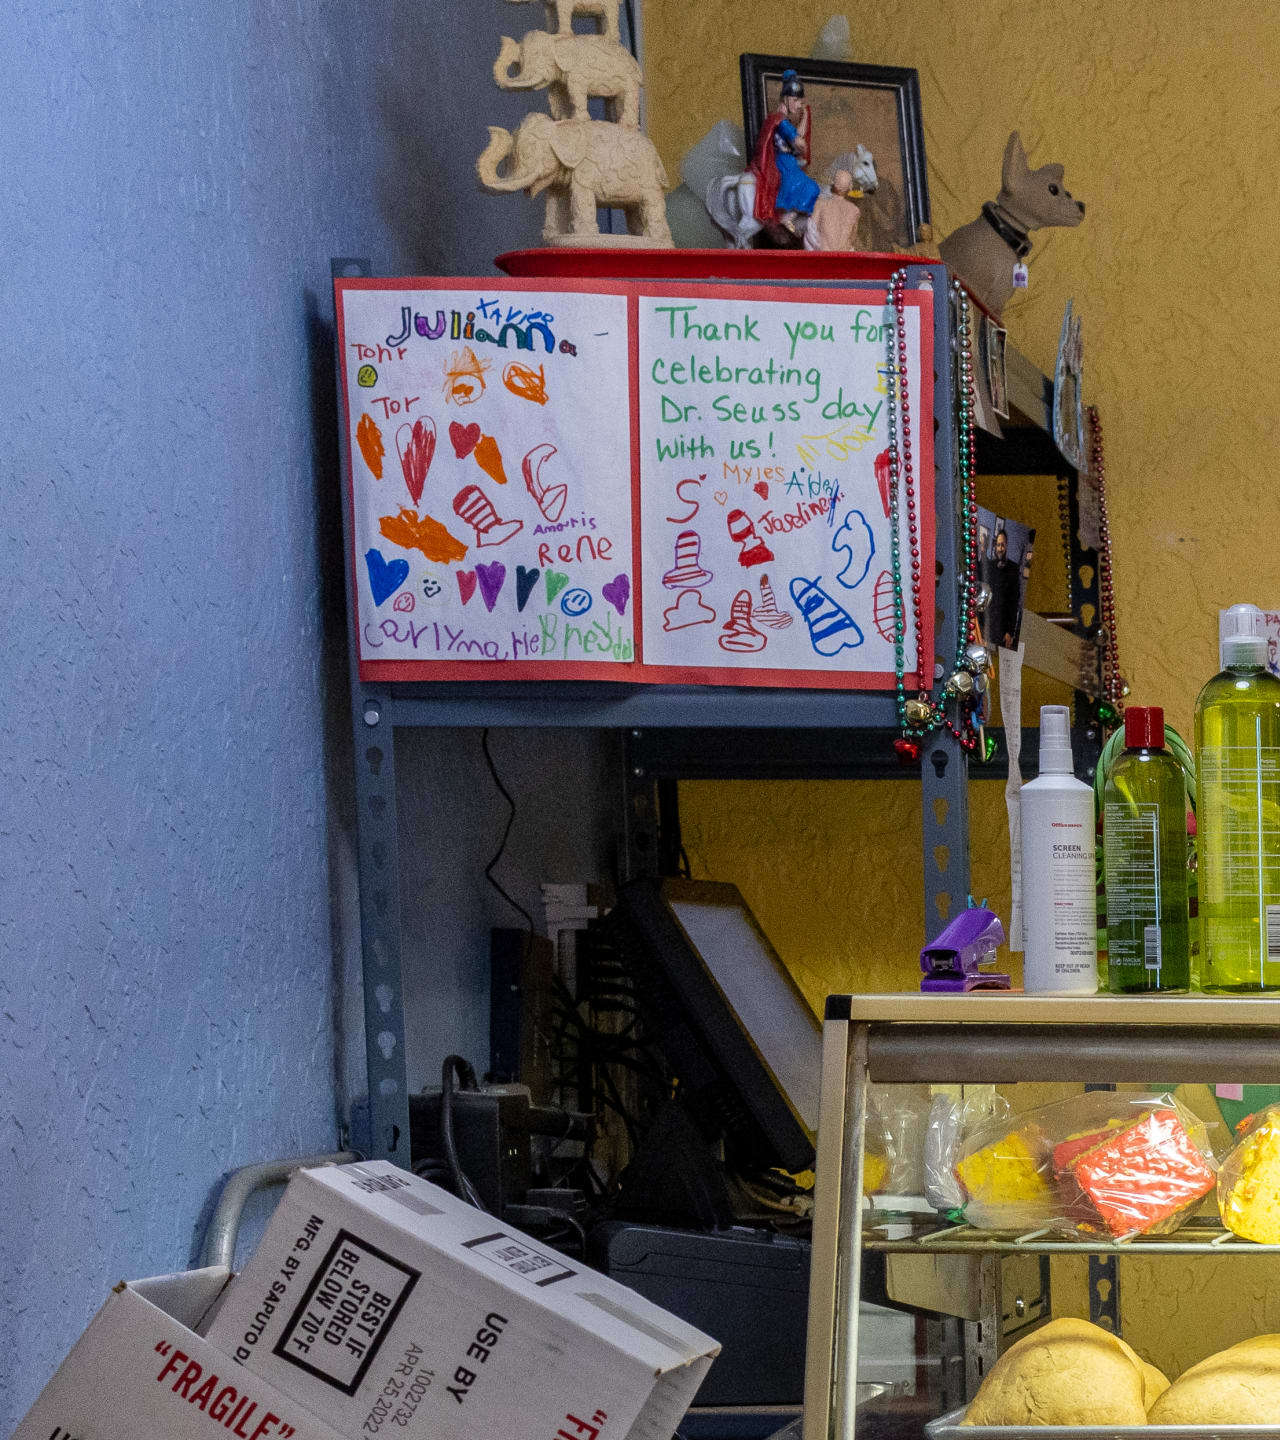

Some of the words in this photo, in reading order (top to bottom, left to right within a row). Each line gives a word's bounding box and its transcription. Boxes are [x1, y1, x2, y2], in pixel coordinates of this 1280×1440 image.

[385, 306, 578, 357] Julianna
[655, 306, 760, 342] Thank
[783, 321, 834, 360] you
[850, 309, 885, 343] for
[661, 395, 702, 423] Dr.
[712, 395, 801, 424] Seuss
[822, 387, 883, 433] day
[730, 432, 776, 461] us!
[290, 1214, 324, 1252] MFG.
[280, 1256, 301, 1282] BY
[315, 1248, 360, 1311] BELOW
[244, 1280, 287, 1346] SAPUTO
[290, 1311, 325, 1355] 70°F
[323, 1279, 371, 1347] STORED
[360, 1290, 392, 1338] BEST
[345, 1338, 367, 1360] IF
[395, 1342, 423, 1376] APR
[466, 1312, 509, 1364] USE
[391, 1369, 435, 1427] 1002732
[446, 1365, 477, 1404] BY
